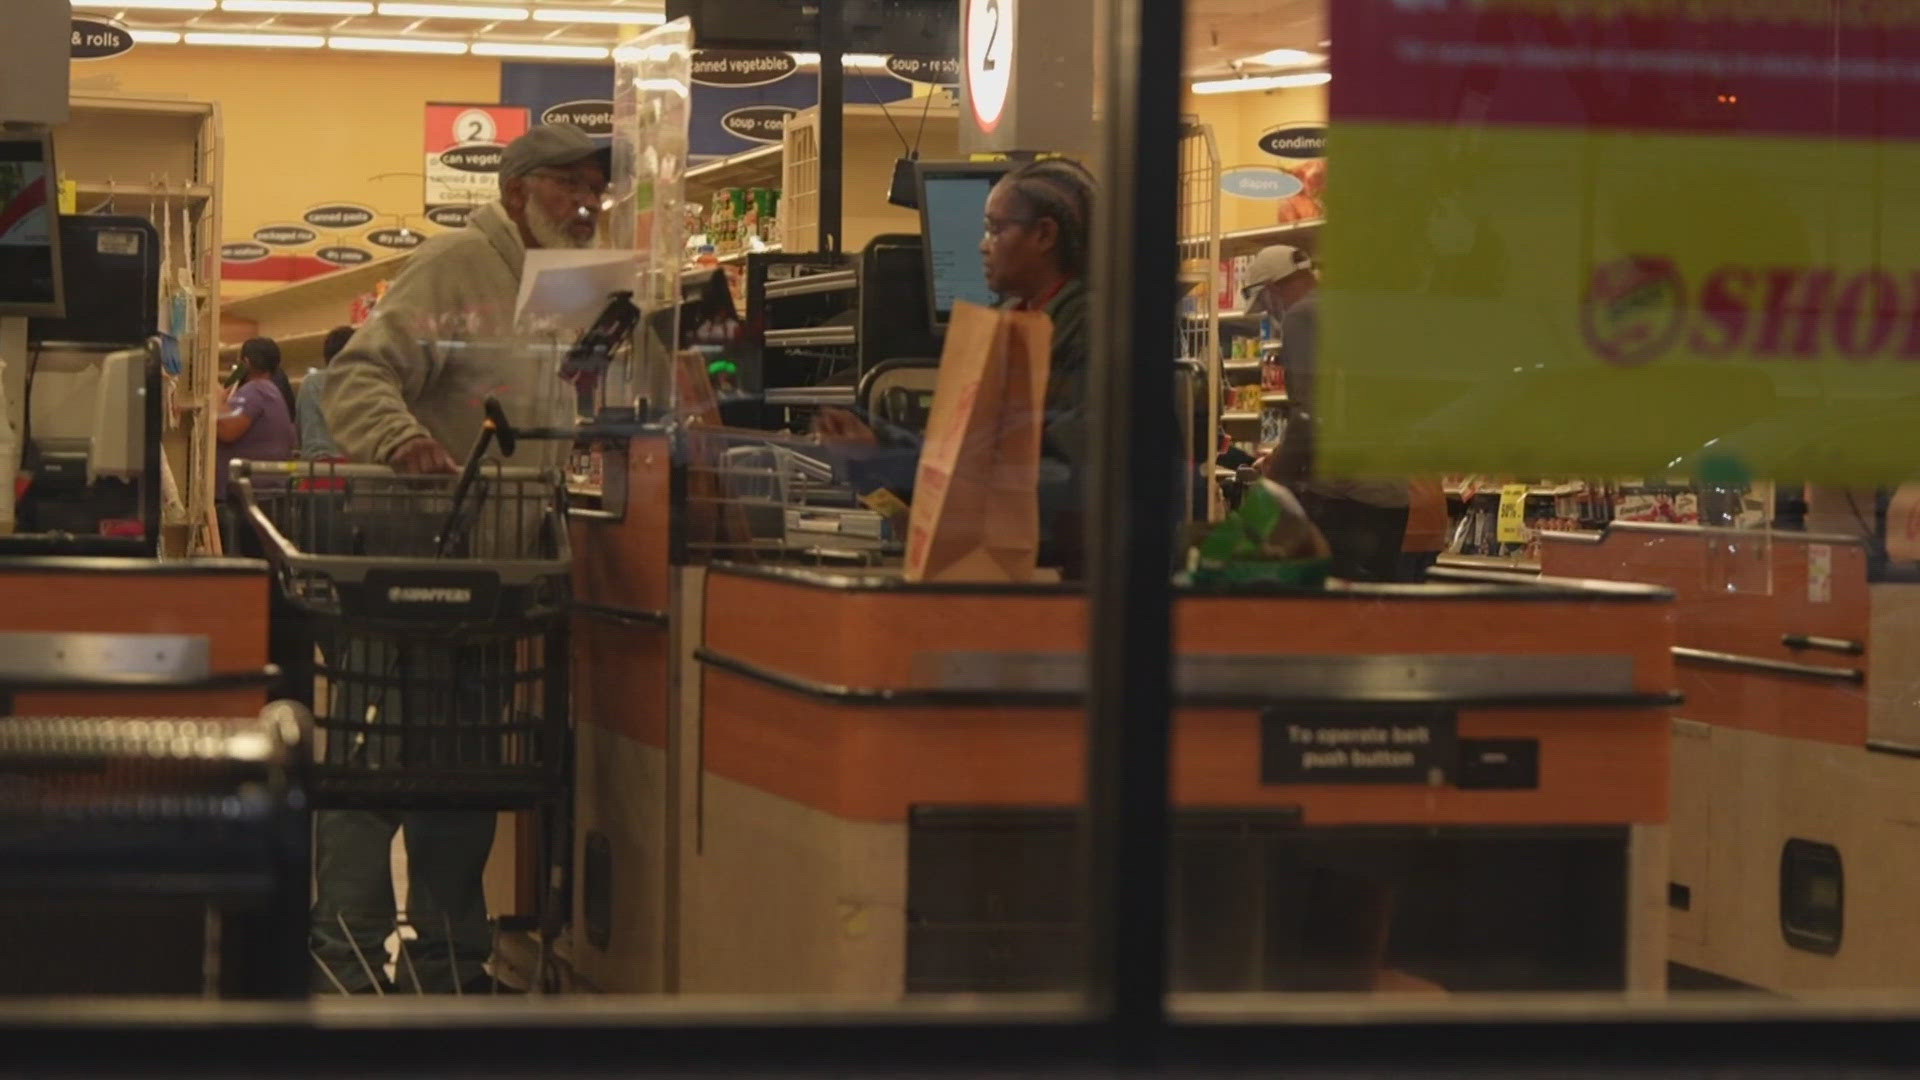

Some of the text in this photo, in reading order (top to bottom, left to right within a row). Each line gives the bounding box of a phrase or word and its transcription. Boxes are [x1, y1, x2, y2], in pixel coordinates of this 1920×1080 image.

[71, 31, 120, 47] & rolls
[983, 0, 999, 71] 2
[691, 56, 788, 74] anned vegetables
[892, 59, 919, 73] soup
[547, 113, 570, 124] can
[729, 117, 755, 130] soup
[468, 121, 483, 141] 2
[443, 154, 463, 164] can
[1239, 177, 1279, 190] diapers
[308, 211, 368, 223] canned pasta
[1289, 724, 1430, 746] To operate belt
[1301, 749, 1415, 769] push button
